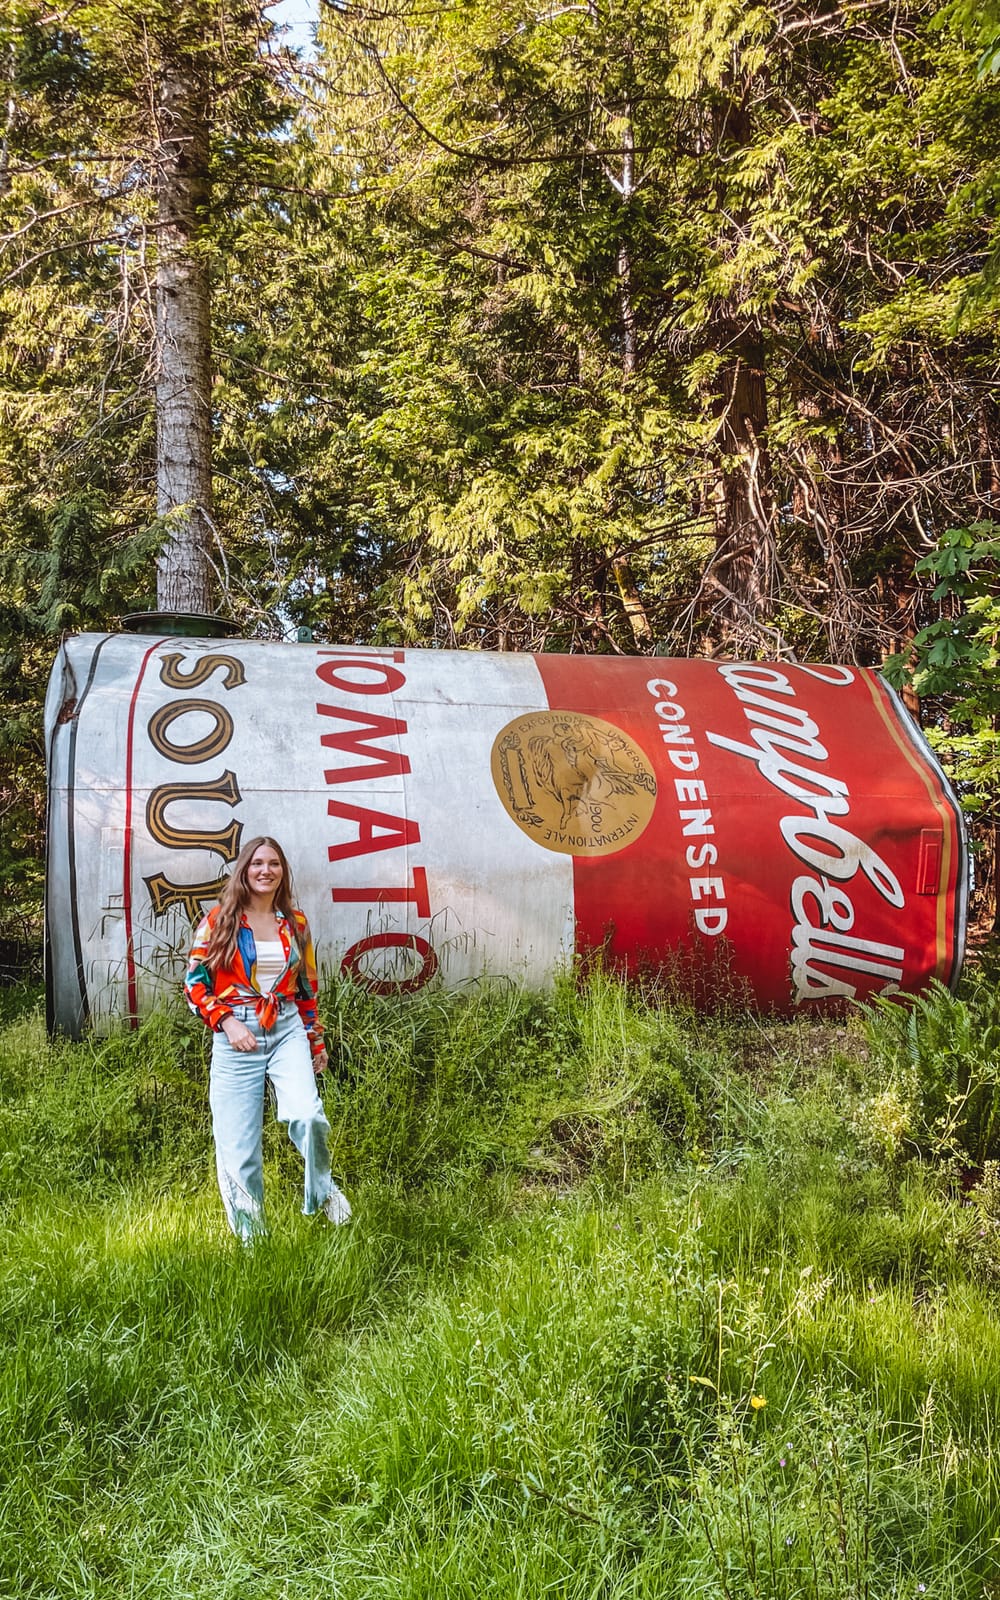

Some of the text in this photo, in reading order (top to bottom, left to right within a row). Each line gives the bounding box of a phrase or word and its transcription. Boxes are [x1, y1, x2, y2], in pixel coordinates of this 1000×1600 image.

[315, 650, 438, 995] TOMATO
[543, 812, 641, 848] INTERNATIONALE
[588, 801, 604, 834] 1900
[646, 677, 729, 937] CONDENSED
